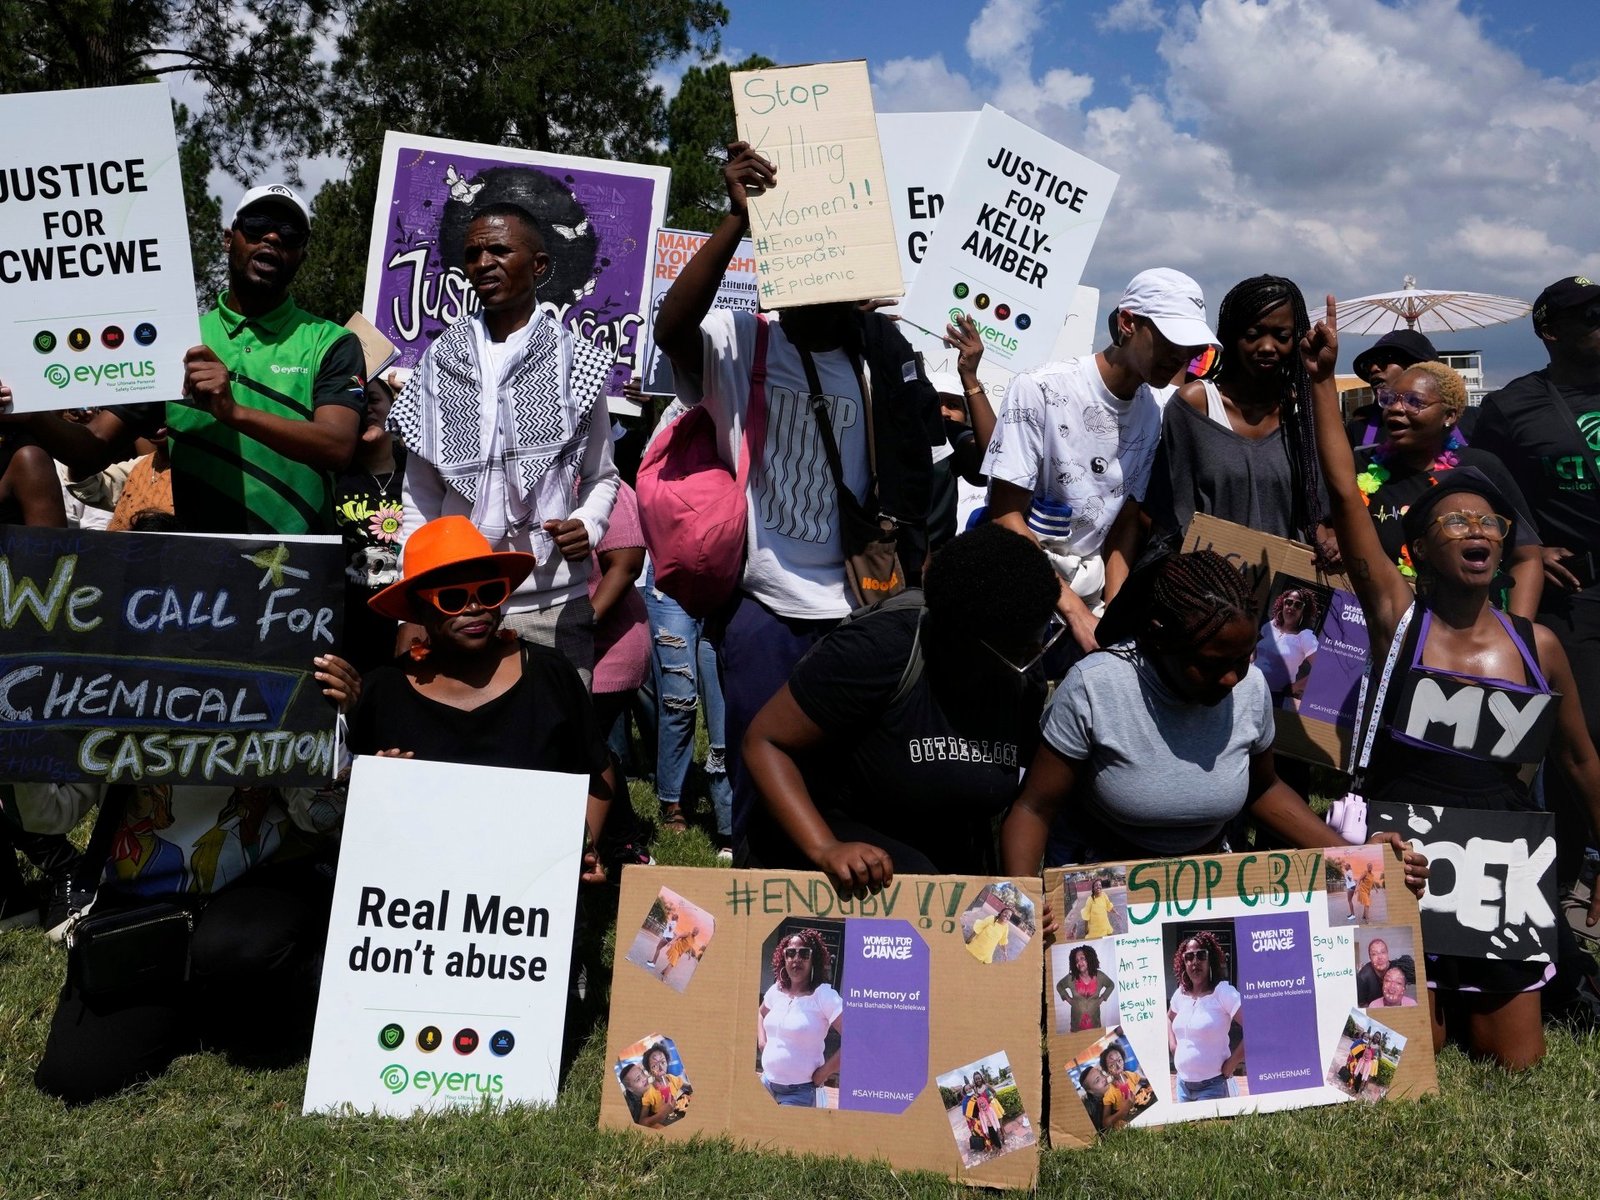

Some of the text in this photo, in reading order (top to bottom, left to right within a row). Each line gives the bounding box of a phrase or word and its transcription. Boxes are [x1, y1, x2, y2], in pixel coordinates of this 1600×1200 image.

[744, 78, 829, 114] Stop
[745, 123, 844, 184] Killing
[0, 158, 148, 204] JUSTICE
[987, 147, 1088, 213] JUSTICE
[751, 179, 873, 231] Women!!
[908, 186, 944, 219] En
[1005, 189, 1046, 225] FOR
[43, 208, 105, 240] FOR
[976, 203, 1052, 255] KELLY-
[756, 226, 837, 255] #Enough
[0, 238, 161, 283] CWECWE
[758, 245, 846, 274] #StopGBV
[961, 230, 1048, 289] AMBER
[761, 270, 855, 297] #Epidemic
[717, 296, 749, 306] SAFETY
[74, 360, 155, 386] eyerus
[0, 554, 103, 632] We
[126, 588, 236, 631] CALL
[1335, 639, 1366, 655] Memory
[0, 665, 267, 722] CHEMICAL
[1405, 677, 1551, 758] MY
[79, 728, 334, 783] CASTRATION
[1127, 859, 1222, 925] STOP
[357, 886, 549, 937] Real Men
[863, 935, 912, 945] WOMEN FOR
[1251, 928, 1293, 940] WOMEN FOR
[1252, 937, 1295, 952] CHANGE
[1313, 935, 1349, 949] Say No
[445, 942, 547, 982] abuse
[863, 945, 912, 960] CHANGE
[1119, 957, 1148, 972] Am I
[1314, 954, 1324, 962] To
[1119, 979, 1139, 992] Next
[1246, 976, 1305, 990] In Memory of
[1317, 967, 1353, 978] Femicide
[850, 988, 920, 1001] In Memory of
[864, 1001, 892, 1009] Bathabile
[1123, 1013, 1134, 1022] To
[413, 1070, 503, 1096] eyerus
[1259, 1067, 1311, 1081] #SAYHERNAME
[852, 1089, 914, 1101] #SAYHERNAME
